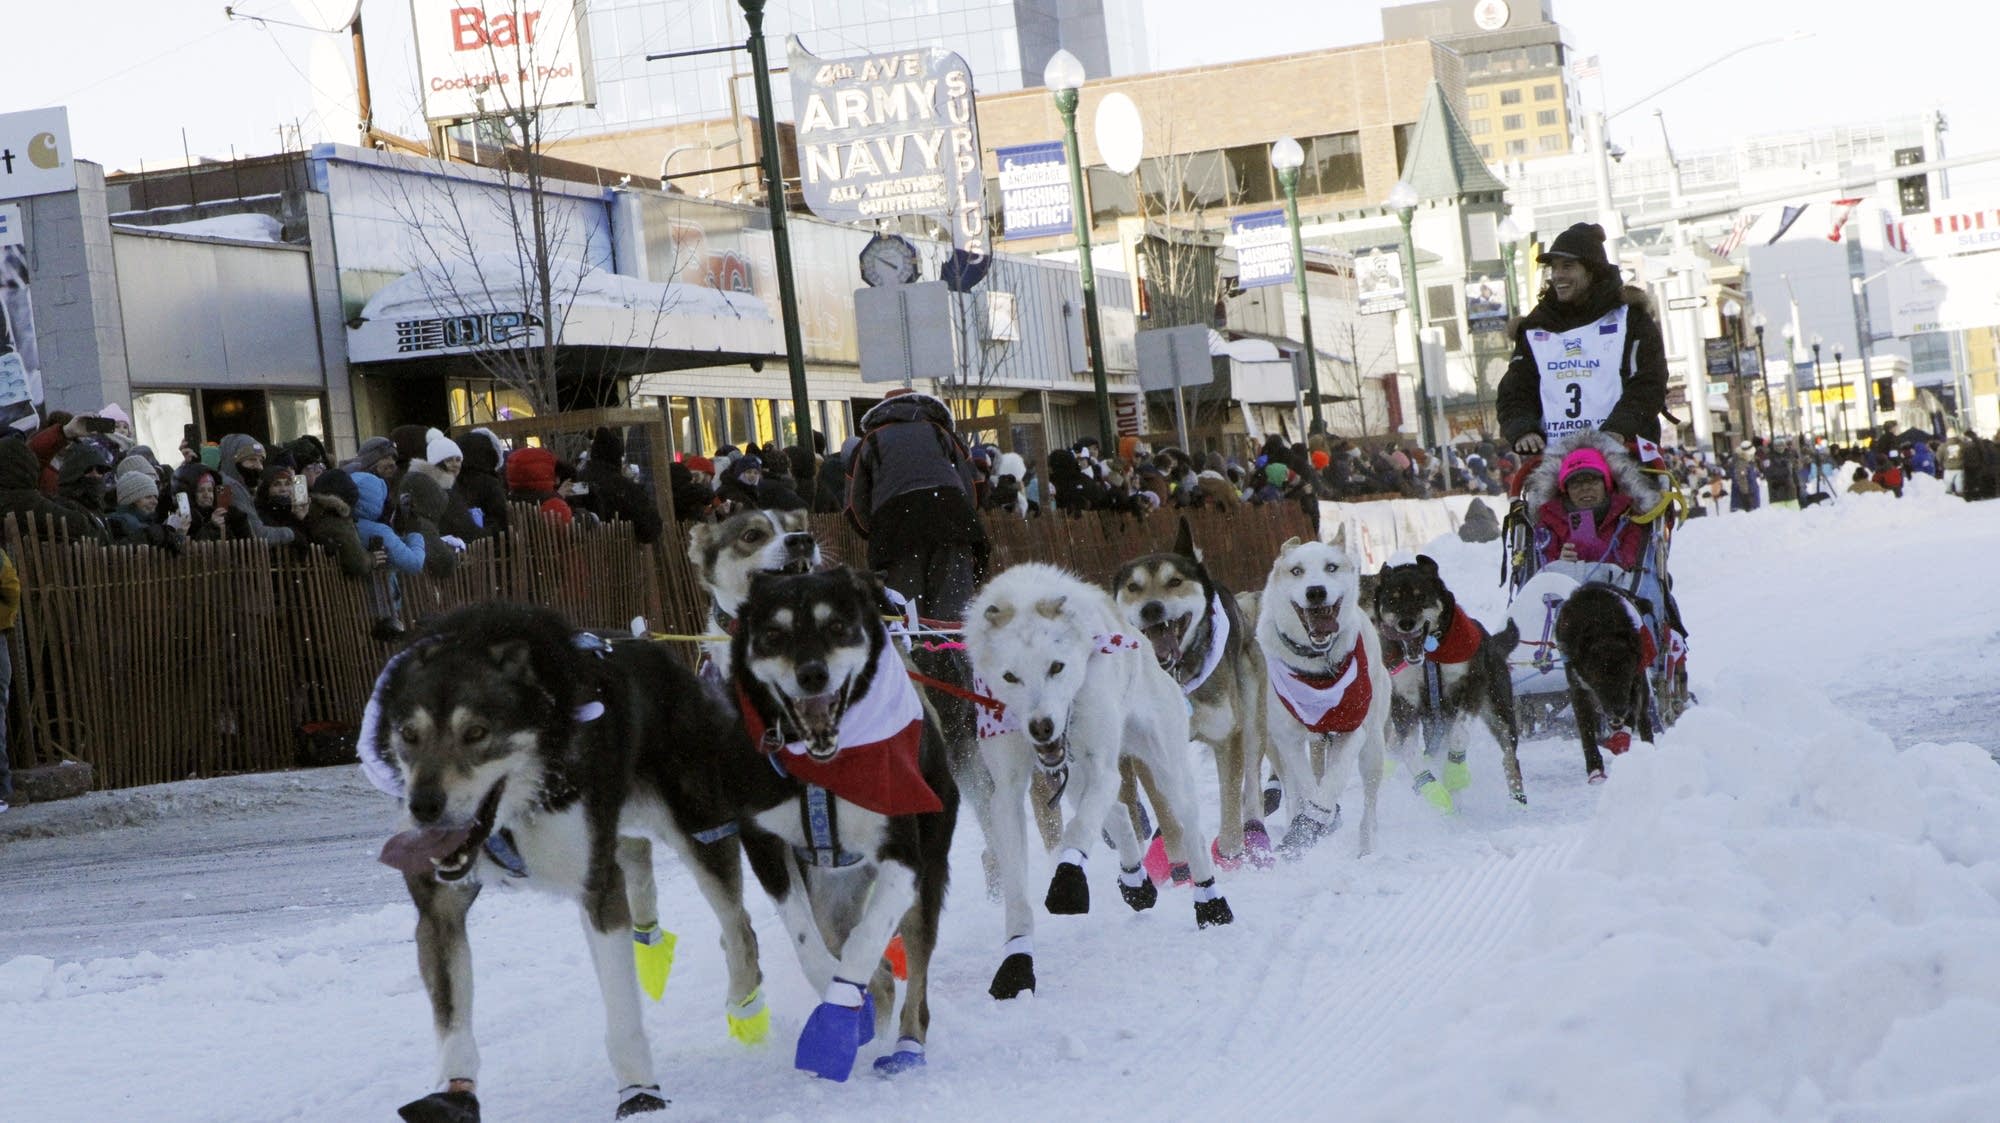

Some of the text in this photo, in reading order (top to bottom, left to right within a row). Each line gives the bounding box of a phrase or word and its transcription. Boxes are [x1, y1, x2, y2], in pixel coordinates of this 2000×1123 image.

[450, 6, 541, 52] Bar
[537, 63, 573, 82] Pool
[815, 53, 921, 87] 4th AVE
[801, 79, 938, 134] ARMY
[804, 128, 945, 184] NAVY
[945, 70, 985, 265] SURPLUS
[828, 184, 862, 204] ALL
[1004, 184, 1070, 210] MUSHING
[1005, 204, 1070, 230] DISTRICT
[1547, 359, 1600, 370] DONLIN
[1556, 370, 1592, 379] GOLD
[1565, 382, 1582, 419] 3
